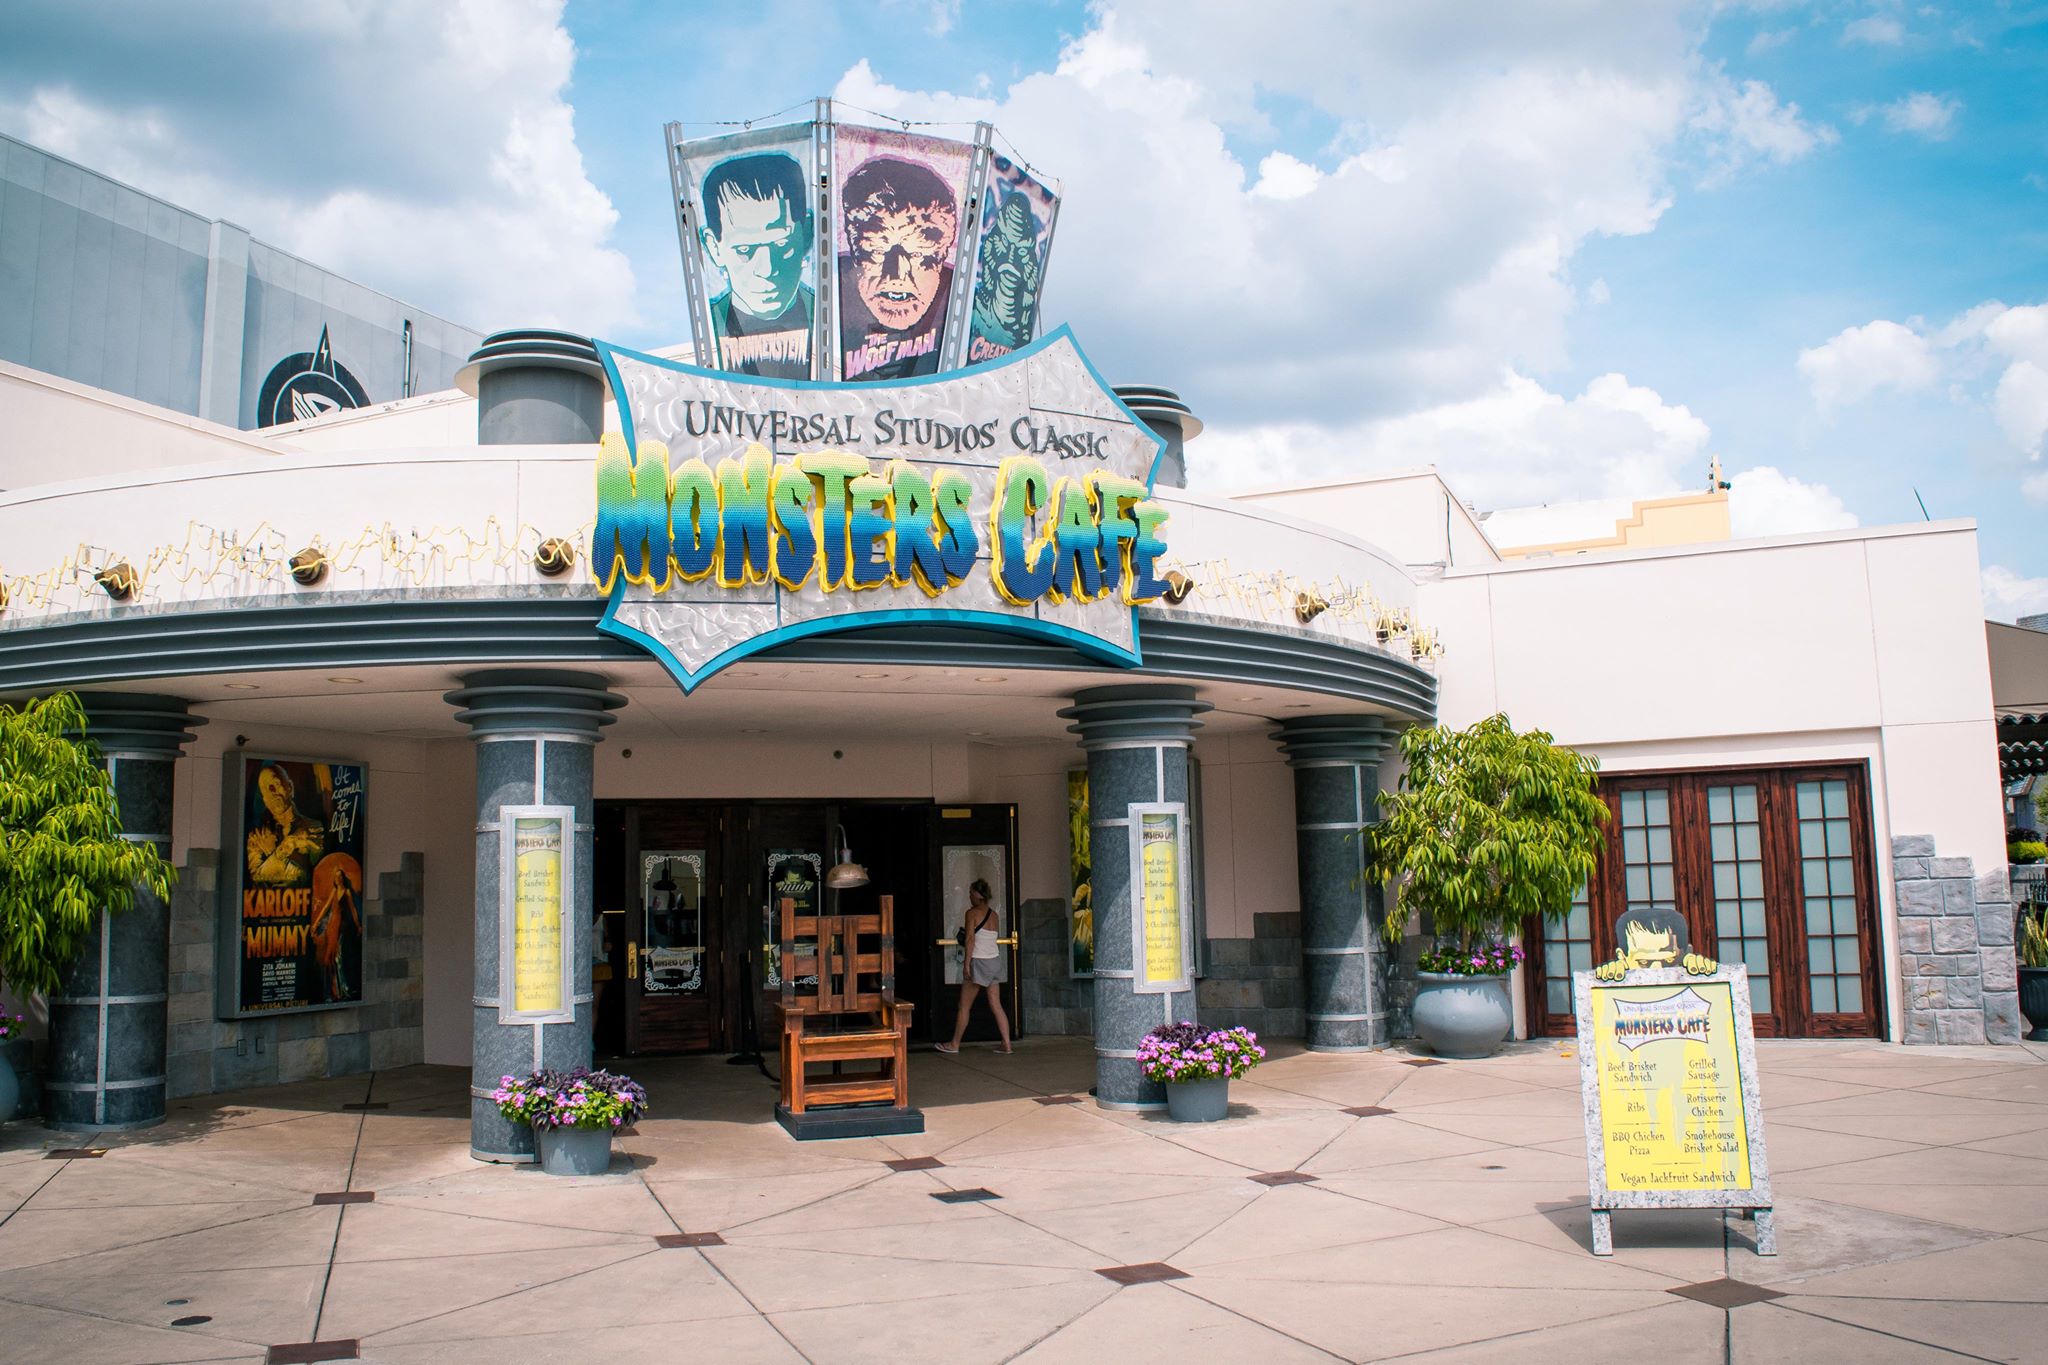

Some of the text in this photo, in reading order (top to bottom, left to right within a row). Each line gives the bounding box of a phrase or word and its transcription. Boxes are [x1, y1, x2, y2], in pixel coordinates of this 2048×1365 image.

[864, 332, 888, 346] THE
[719, 328, 809, 371] FRANKENSTEIN
[845, 328, 936, 380] WOLF MAN
[970, 336, 1016, 361] CREAT
[684, 400, 1108, 460] UNIVERSAL STUDIOS' CLASSIC
[590, 432, 1170, 606] MONSTERS CAFE
[335, 766, 351, 786] It
[331, 780, 362, 801] comes
[337, 799, 351, 811] to
[329, 795, 358, 843] life!
[243, 888, 311, 918] KARLOFF
[247, 924, 311, 959] MUMMY
[1615, 1012, 1711, 1036] MONSTERS CAFE
[1608, 1060, 1657, 1072] Beef Brisket
[1689, 1058, 1717, 1069] Grilled
[1614, 1072, 1652, 1082] Sandwich
[1688, 1070, 1720, 1083] Sausage
[1687, 1093, 1727, 1103] Rotisserie
[1627, 1102, 1646, 1112] Ribs
[1691, 1106, 1724, 1117] Chicken
[1612, 1130, 1665, 1143] BBQ Chicken
[1685, 1129, 1735, 1140] Smokehouse
[1629, 1145, 1650, 1156] Pizza
[1684, 1141, 1739, 1153] Brisket Salad
[1620, 1170, 1736, 1187] Vegan Jackfruit Sandwich
